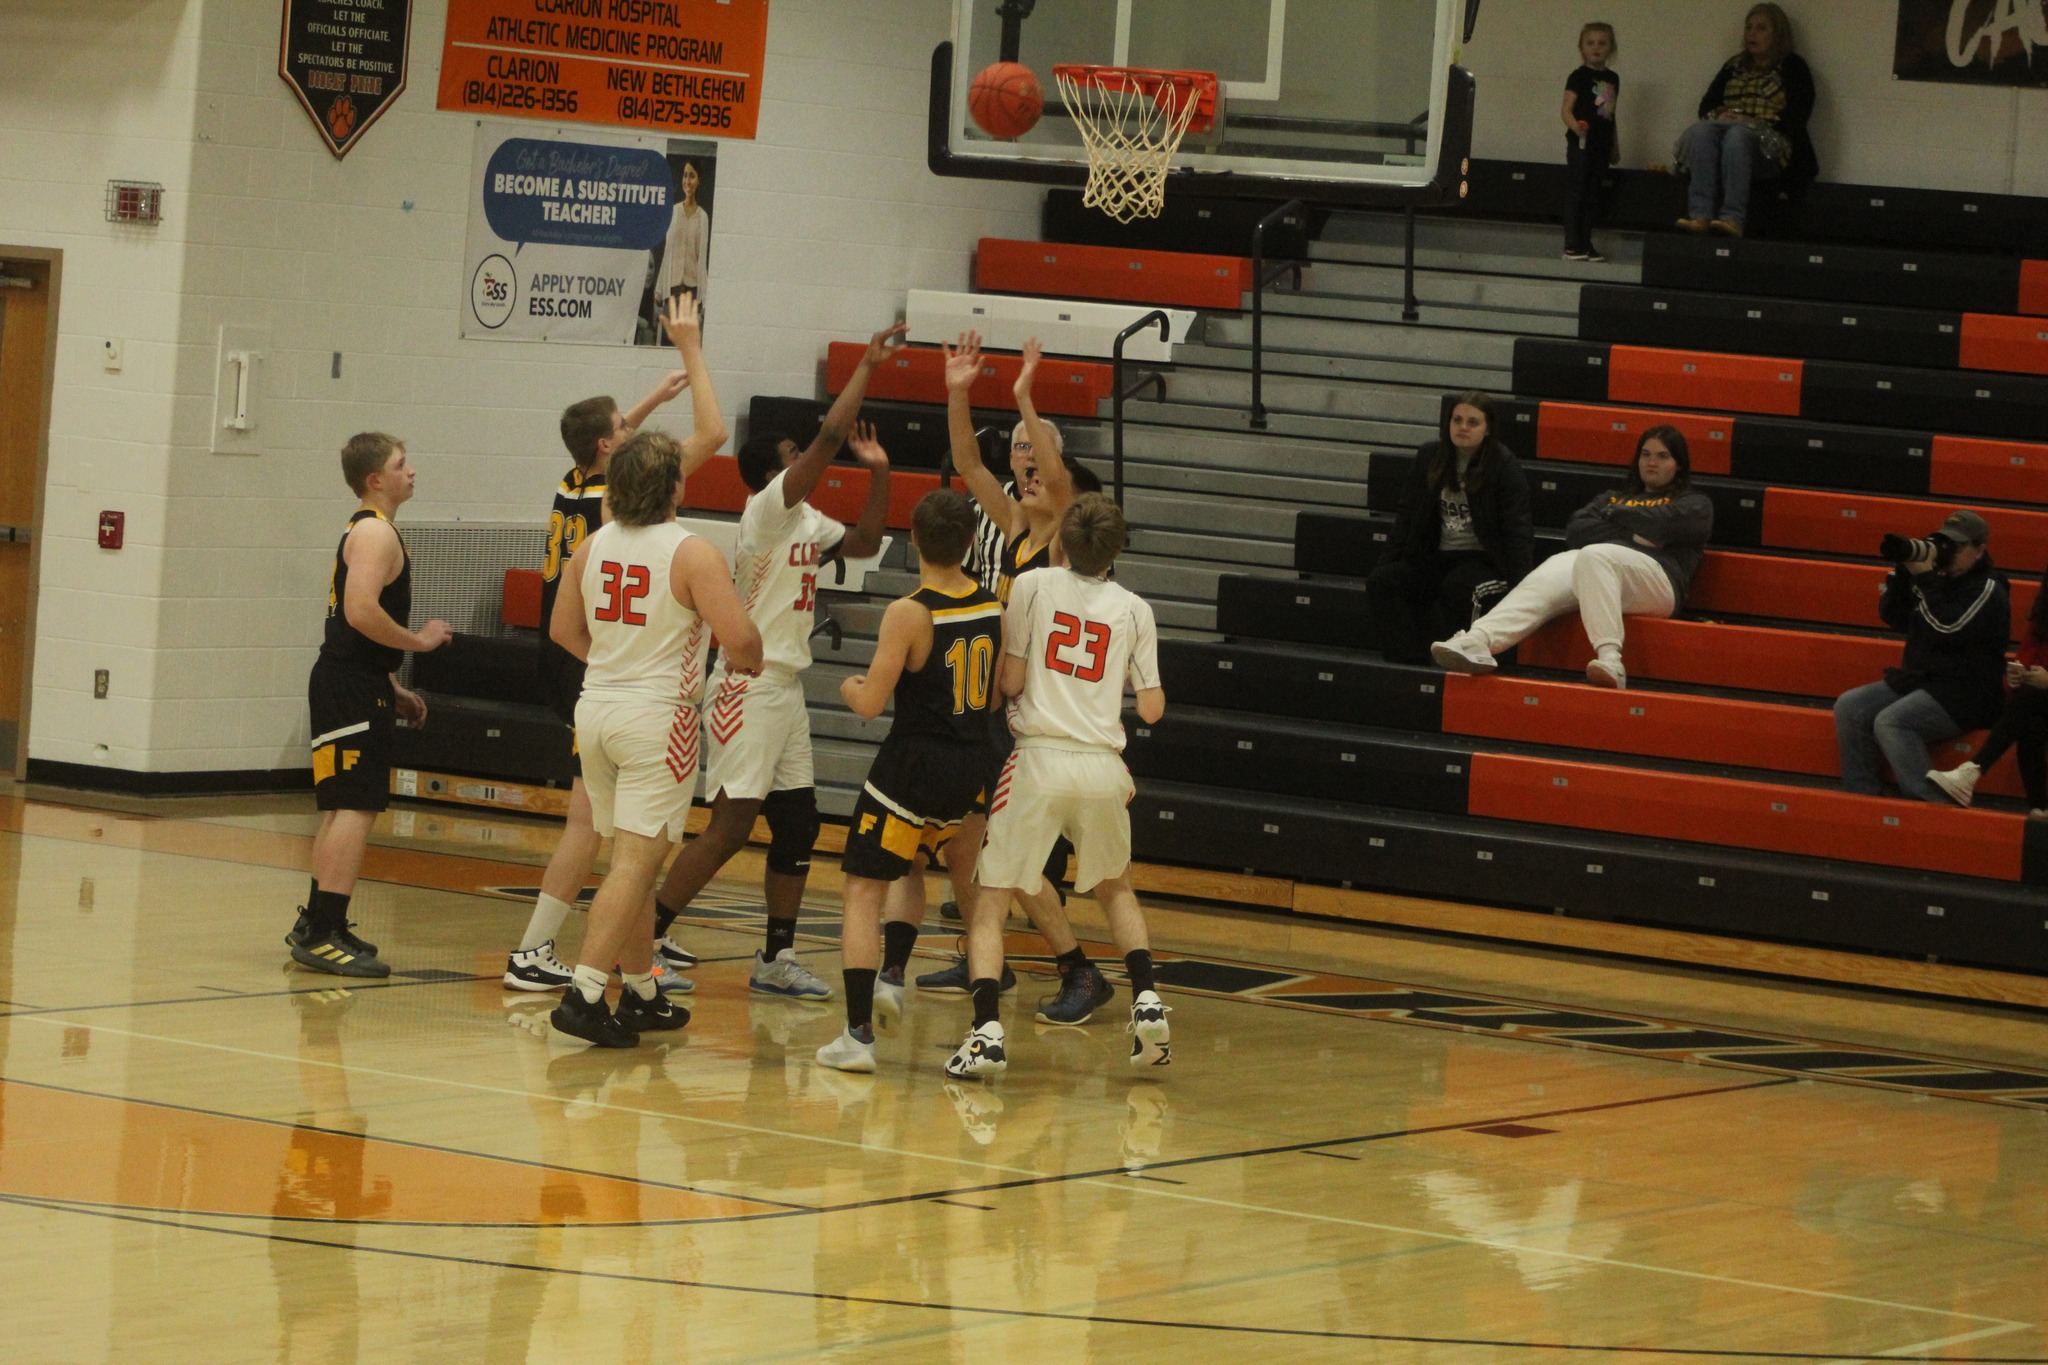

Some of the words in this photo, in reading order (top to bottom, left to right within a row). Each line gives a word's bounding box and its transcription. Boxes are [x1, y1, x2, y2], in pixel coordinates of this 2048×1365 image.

[333, 9, 349, 21] LET
[350, 11, 366, 23] THE
[608, 0, 682, 28] HOSPITAL
[307, 22, 347, 37] OFFICIALS
[348, 27, 391, 42] OFFICIATE.
[486, 15, 559, 47] ATHLETIC
[565, 24, 640, 56] MEDICINE
[646, 35, 723, 65] PROGRAM
[331, 41, 347, 53] LET
[348, 42, 363, 54] THE
[298, 52, 345, 68] SPECTATORS
[346, 58, 357, 69] BE
[359, 60, 395, 74] POSITIVE.
[487, 54, 559, 84] CLARION
[607, 67, 646, 94] NEW
[652, 71, 746, 103] BETHLEHEM
[617, 94, 732, 129] (814)275-9936
[494, 173, 560, 198] BECOME
[562, 179, 575, 199] A
[577, 180, 667, 206] SUBSTITUTE
[542, 201, 617, 226] TEACHER!
[530, 273, 574, 294] APPLY
[577, 276, 626, 297] TODAY
[528, 297, 593, 319] ESS.COM
[594, 560, 651, 627] 32
[1045, 610, 1112, 683] 23
[945, 635, 994, 715] 10
[341, 750, 361, 771] F
[857, 812, 878, 835] F
